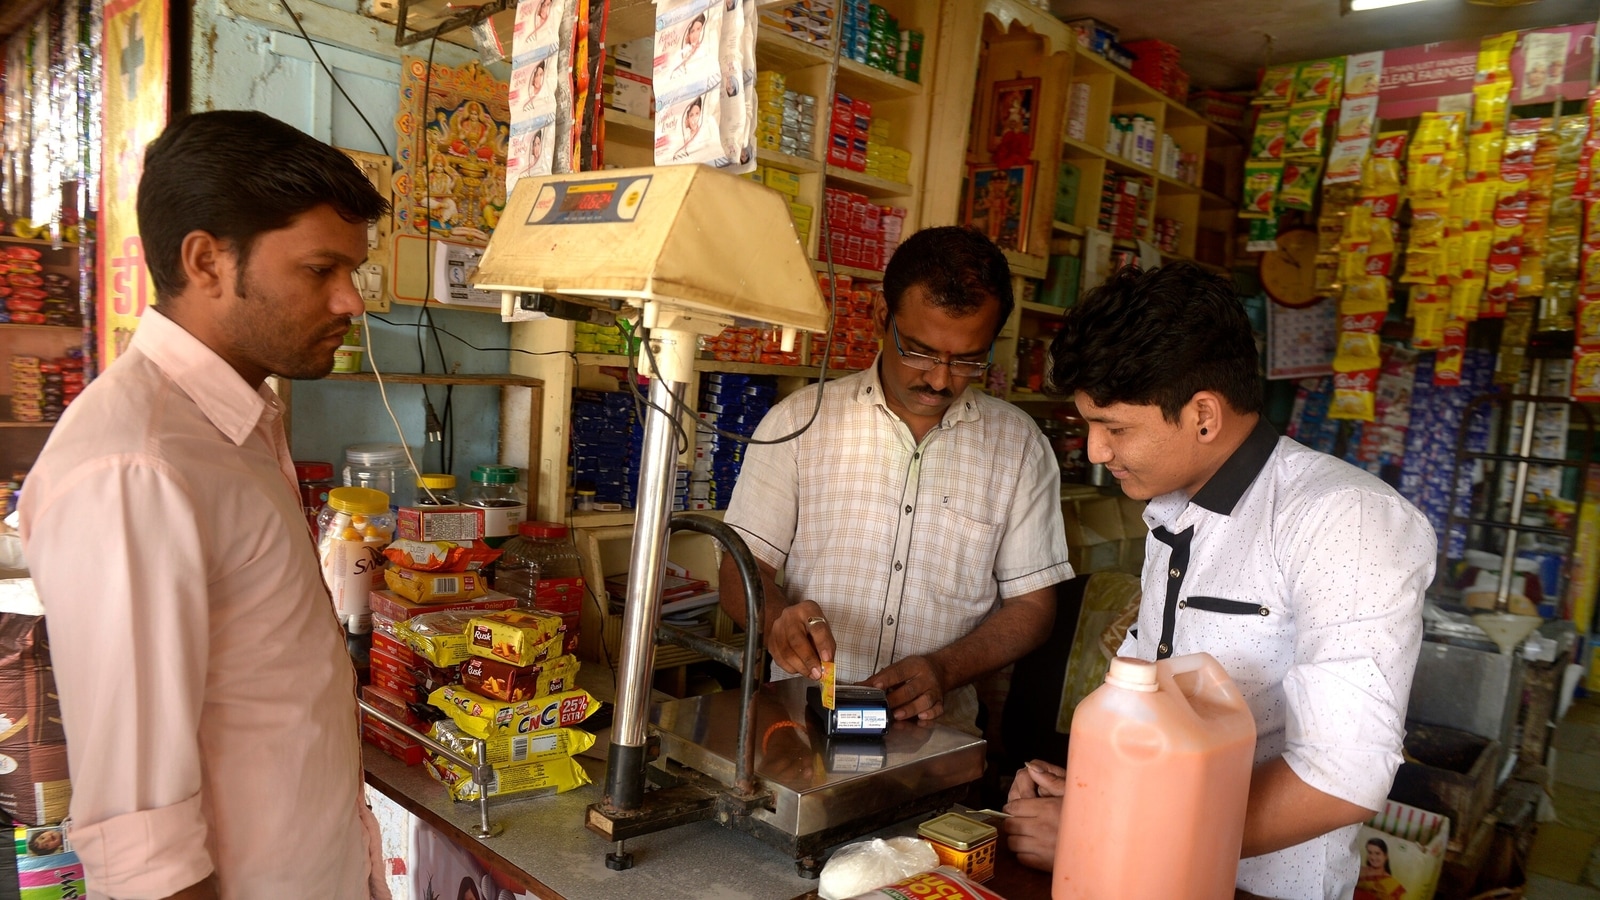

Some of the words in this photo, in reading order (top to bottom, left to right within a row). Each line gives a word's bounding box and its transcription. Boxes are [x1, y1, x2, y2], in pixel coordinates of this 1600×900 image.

[1417, 64, 1475, 81] FAIRNESS
[484, 602, 504, 610] Onion
[474, 630, 491, 641] Rusk
[467, 666, 483, 677] Rusk
[563, 696, 587, 713] 25%
